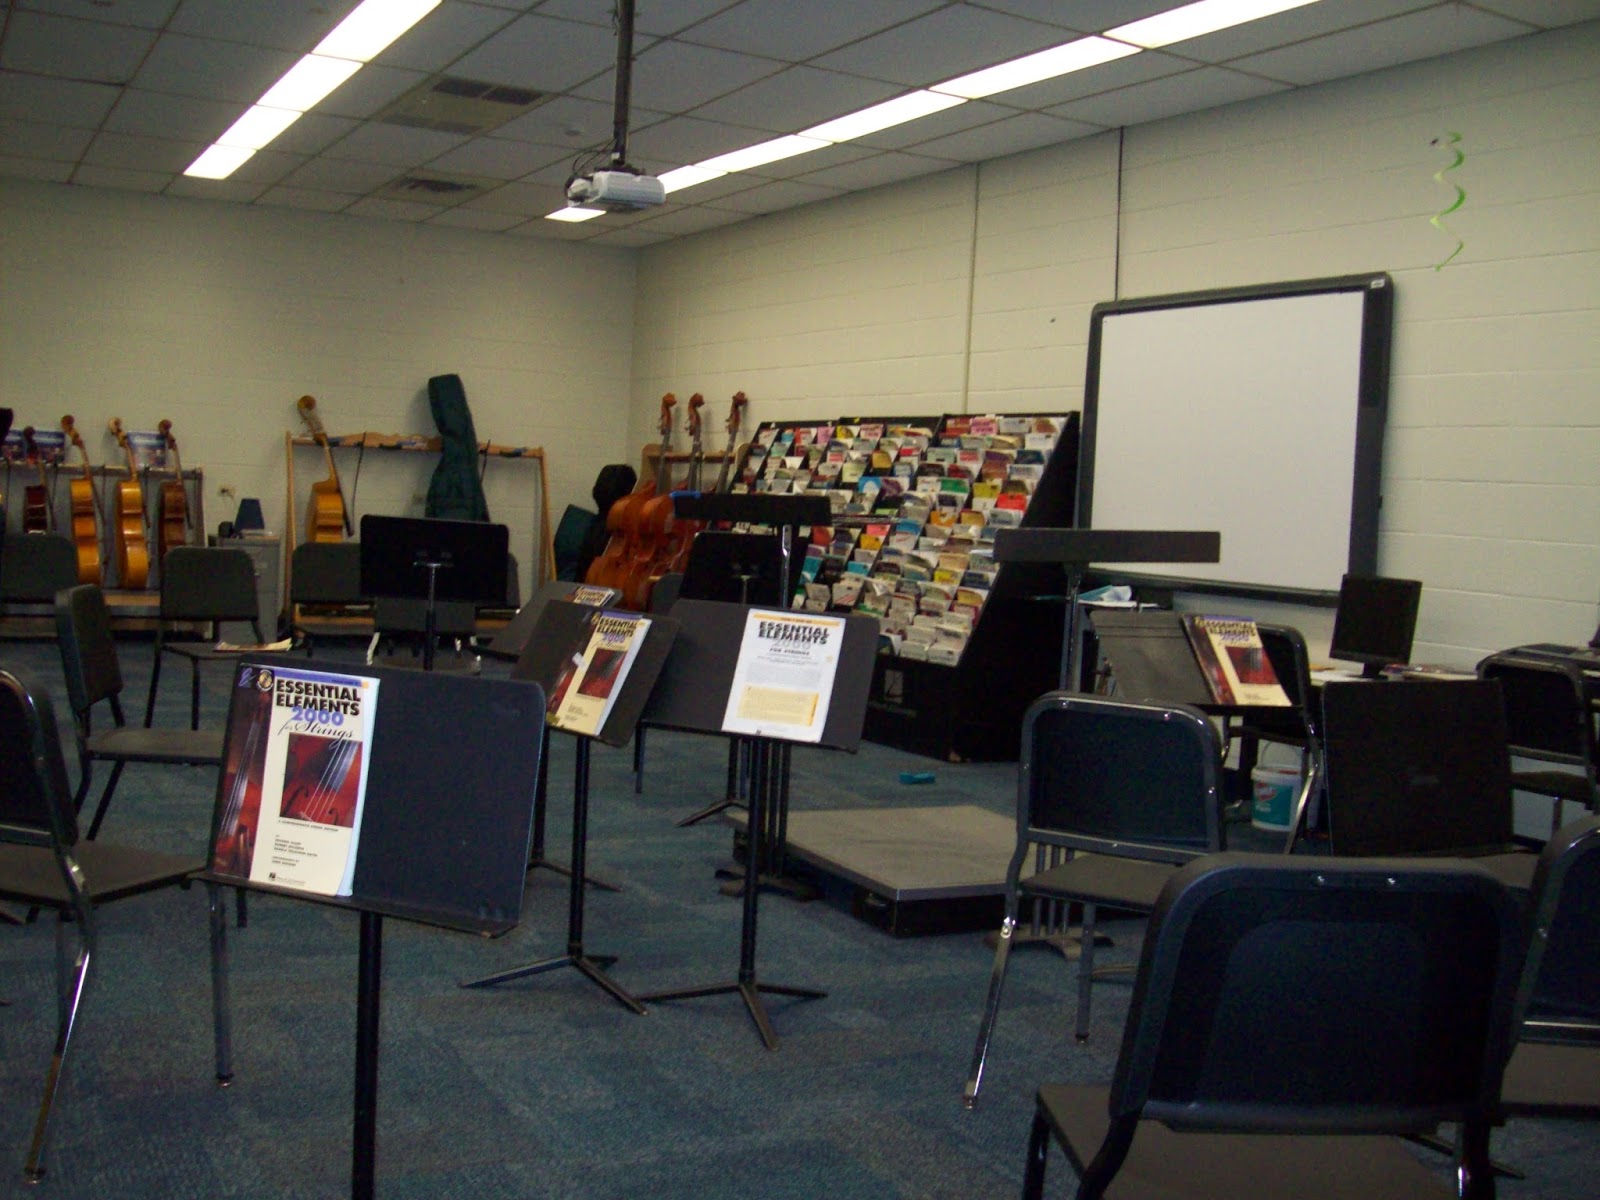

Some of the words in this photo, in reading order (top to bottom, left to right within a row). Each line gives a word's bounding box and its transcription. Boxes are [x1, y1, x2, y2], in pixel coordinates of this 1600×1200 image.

[597, 626, 634, 637] ELEMENTS
[599, 618, 637, 630] ESSENTIAL
[760, 621, 829, 637] ESSENTIAL
[758, 629, 828, 645] ELEMENTS
[772, 639, 812, 650] 2000
[276, 679, 361, 702] ESSENTIAL
[276, 693, 360, 716] ELEMENTS
[291, 705, 344, 726] 2000
[295, 719, 353, 749] Strings
